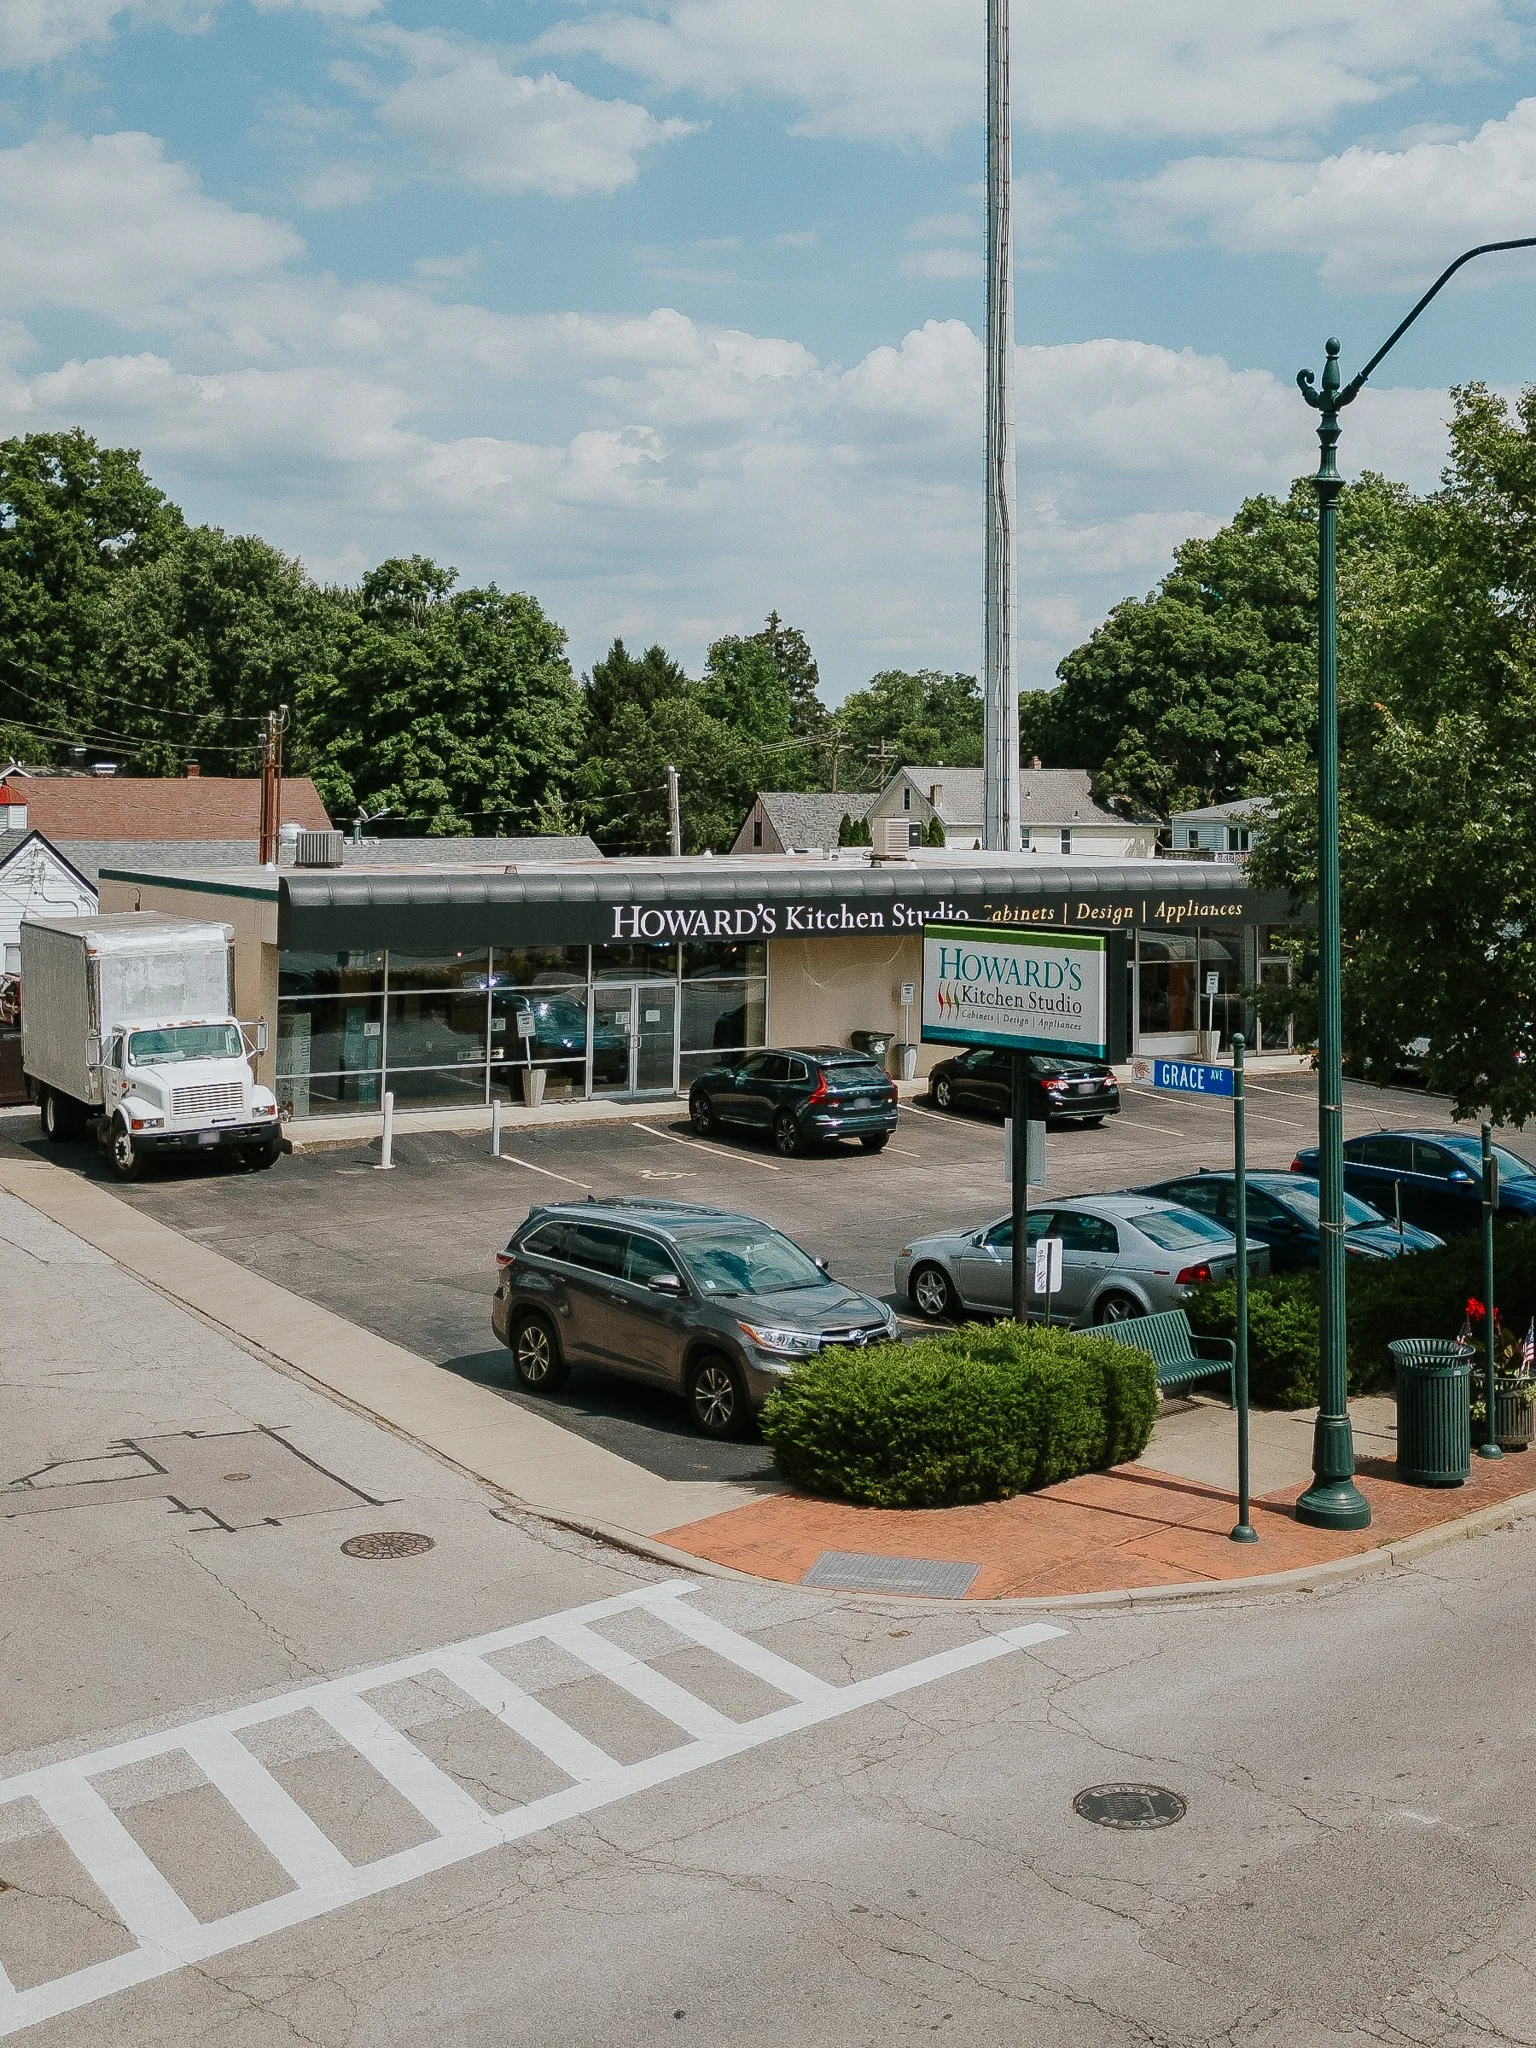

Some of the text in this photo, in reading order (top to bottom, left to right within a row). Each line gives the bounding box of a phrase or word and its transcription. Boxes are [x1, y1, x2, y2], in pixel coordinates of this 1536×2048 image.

[612, 903, 777, 938] HOWARD'S
[785, 903, 885, 930] Kitchen
[1076, 903, 1134, 925] Design
[1154, 899, 1243, 924] Appliances
[938, 946, 1083, 991] HOWARD'S
[961, 985, 1082, 1014] Kitchen Studio
[961, 1009, 1082, 1031] Cabinets Design Appliances
[1162, 1063, 1224, 1090] GRACE AVE
